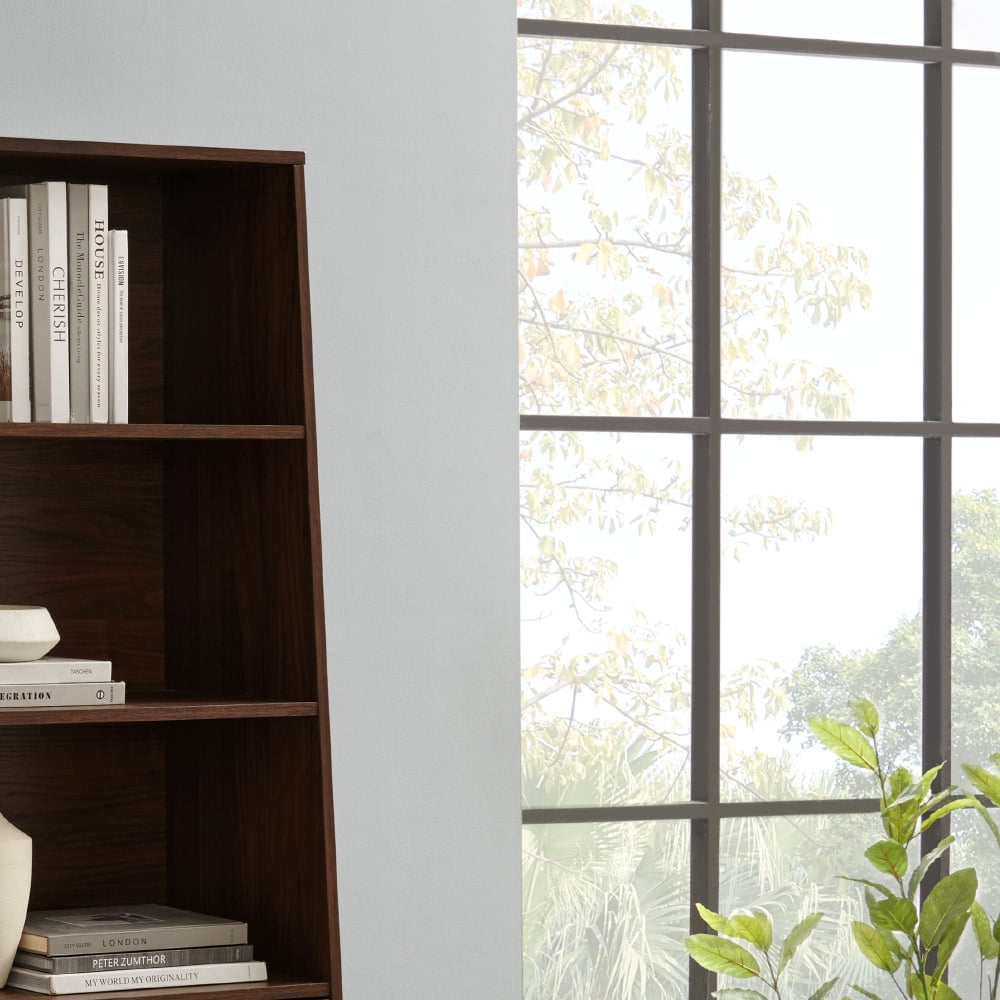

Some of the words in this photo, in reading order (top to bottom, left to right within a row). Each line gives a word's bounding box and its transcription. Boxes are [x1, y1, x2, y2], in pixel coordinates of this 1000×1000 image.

[76, 231, 85, 247] The
[94, 219, 105, 280] HOUSE
[37, 248, 45, 301] LONDON
[117, 256, 125, 286] ENVISION
[14, 260, 24, 328] DEVELOP
[52, 266, 66, 342] CHERISH
[102, 937, 147, 947] LONDON
[92, 958, 119, 969] PETER
[120, 954, 166, 967] ZUMTHOR
[85, 979, 98, 987] MY
[100, 976, 130, 986] WORLD
[131, 975, 144, 984] MY
[145, 972, 199, 983] ORIGINALITY
